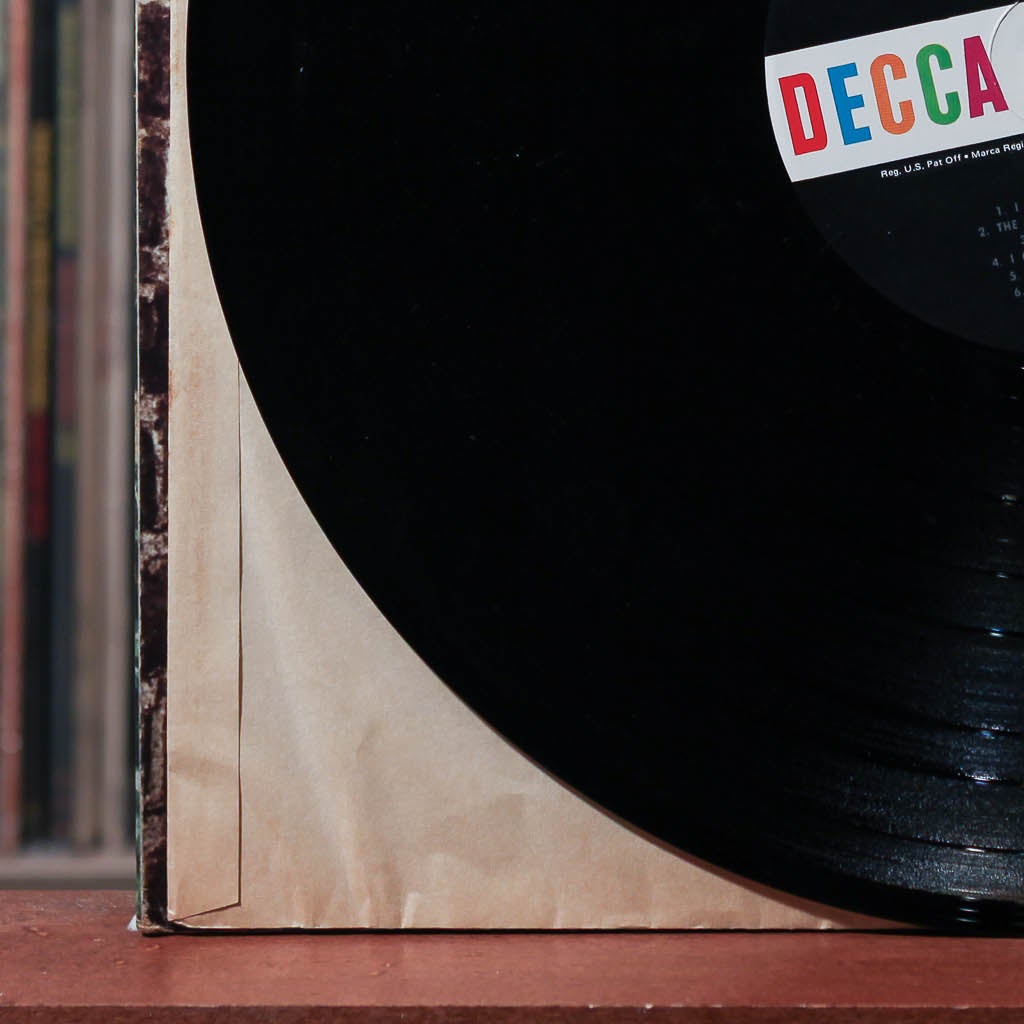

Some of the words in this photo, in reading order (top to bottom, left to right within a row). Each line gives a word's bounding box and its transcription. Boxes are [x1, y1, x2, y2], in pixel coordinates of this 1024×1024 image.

[778, 35, 1009, 156] DECCA
[880, 168, 902, 179] Reg.
[904, 163, 925, 173] U.S.
[927, 158, 944, 168] Pat
[945, 153, 961, 165] Off
[971, 147, 1000, 159] Marca
[996, 219, 1018, 232] THE
